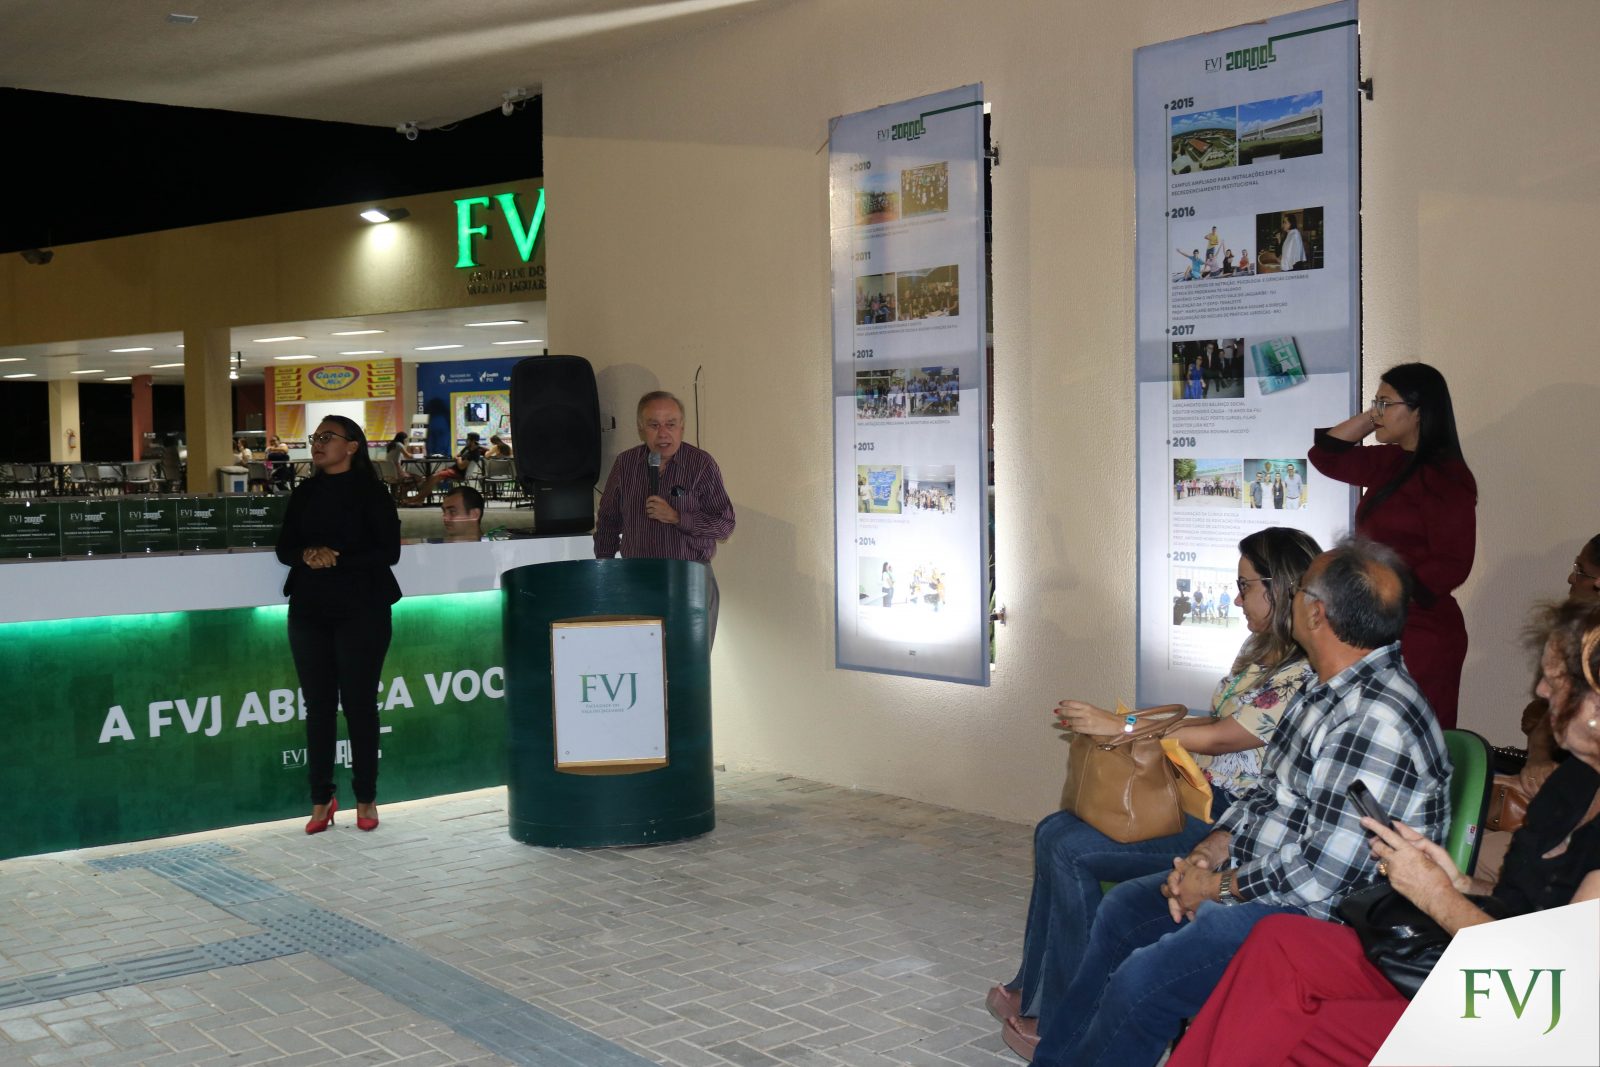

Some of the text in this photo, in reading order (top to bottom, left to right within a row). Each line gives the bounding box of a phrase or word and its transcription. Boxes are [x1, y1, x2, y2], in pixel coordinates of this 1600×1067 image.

[1205, 57, 1222, 71] FVJ
[1170, 97, 1194, 110] 2015
[877, 128, 890, 140] FVJ
[1171, 181, 1191, 189] CAMPUS
[1171, 206, 1195, 218] 2016
[453, 187, 546, 268] FV
[1171, 325, 1195, 335] 2017
[856, 349, 873, 358] 2012
[857, 442, 874, 451] 2013
[1172, 437, 1196, 447] 2018
[859, 537, 876, 545] 2014
[1173, 551, 1196, 562] 2019
[578, 672, 639, 710] FVJ
[98, 666, 504, 744] A FVJ ABA VOC
[282, 748, 308, 766] FVJ
